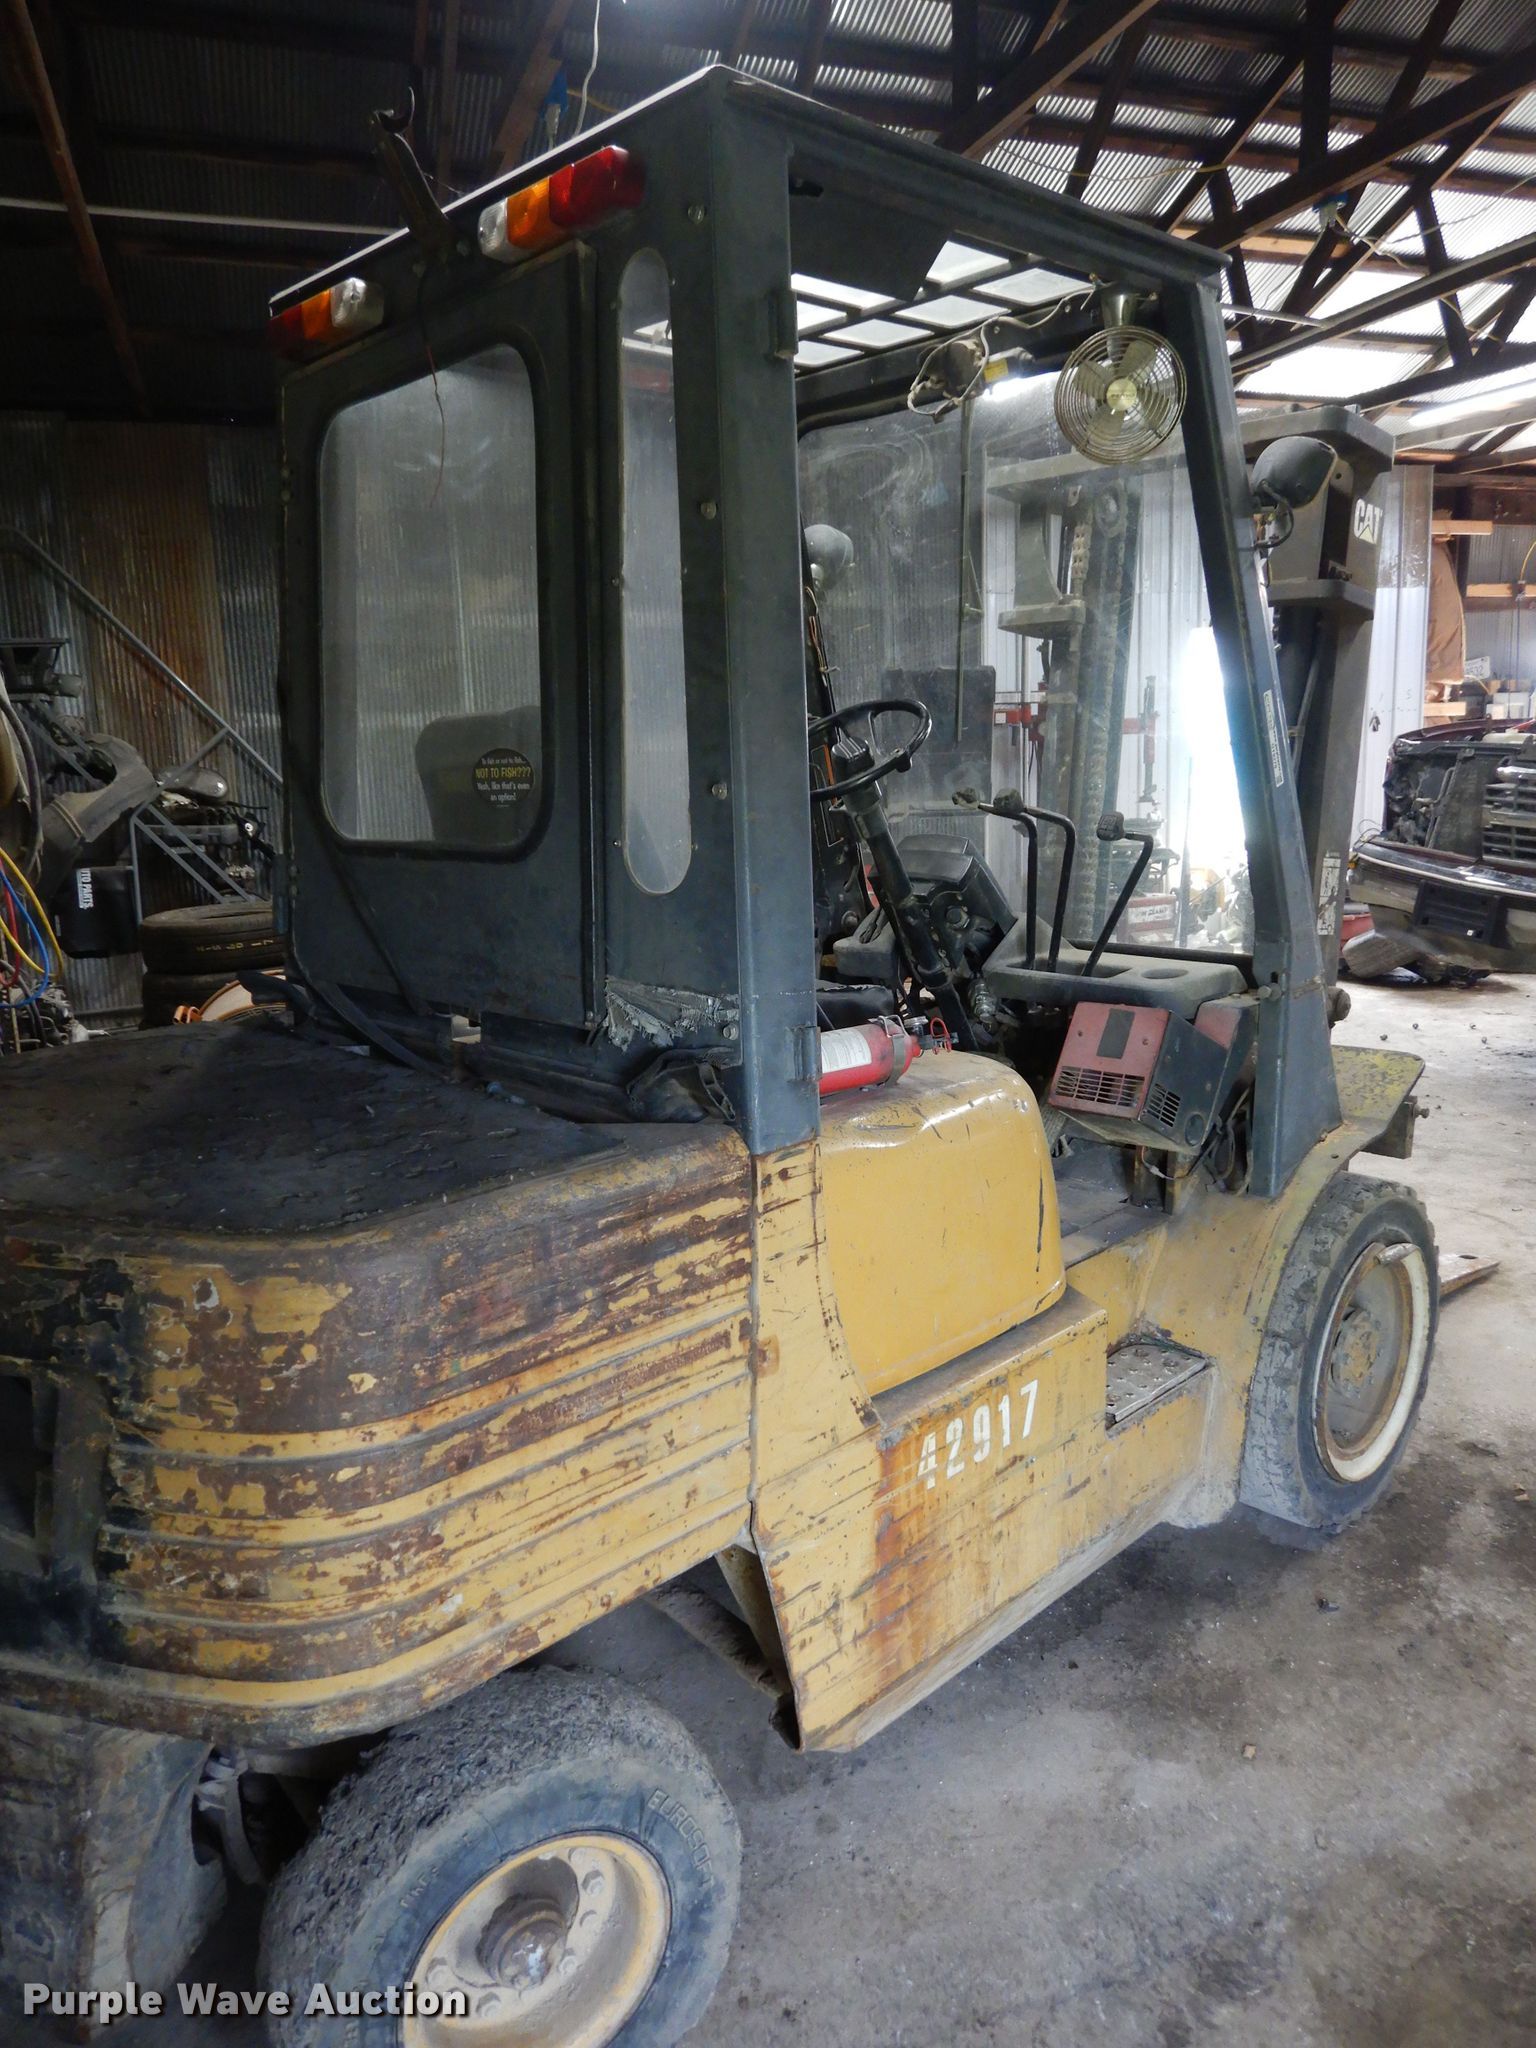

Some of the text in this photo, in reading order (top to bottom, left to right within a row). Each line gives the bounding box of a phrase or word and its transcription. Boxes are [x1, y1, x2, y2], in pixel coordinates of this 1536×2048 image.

[1354, 498, 1383, 545] CAT
[476, 766, 531, 778] NOT TO FISH???
[917, 1379, 1038, 1490] 42917
